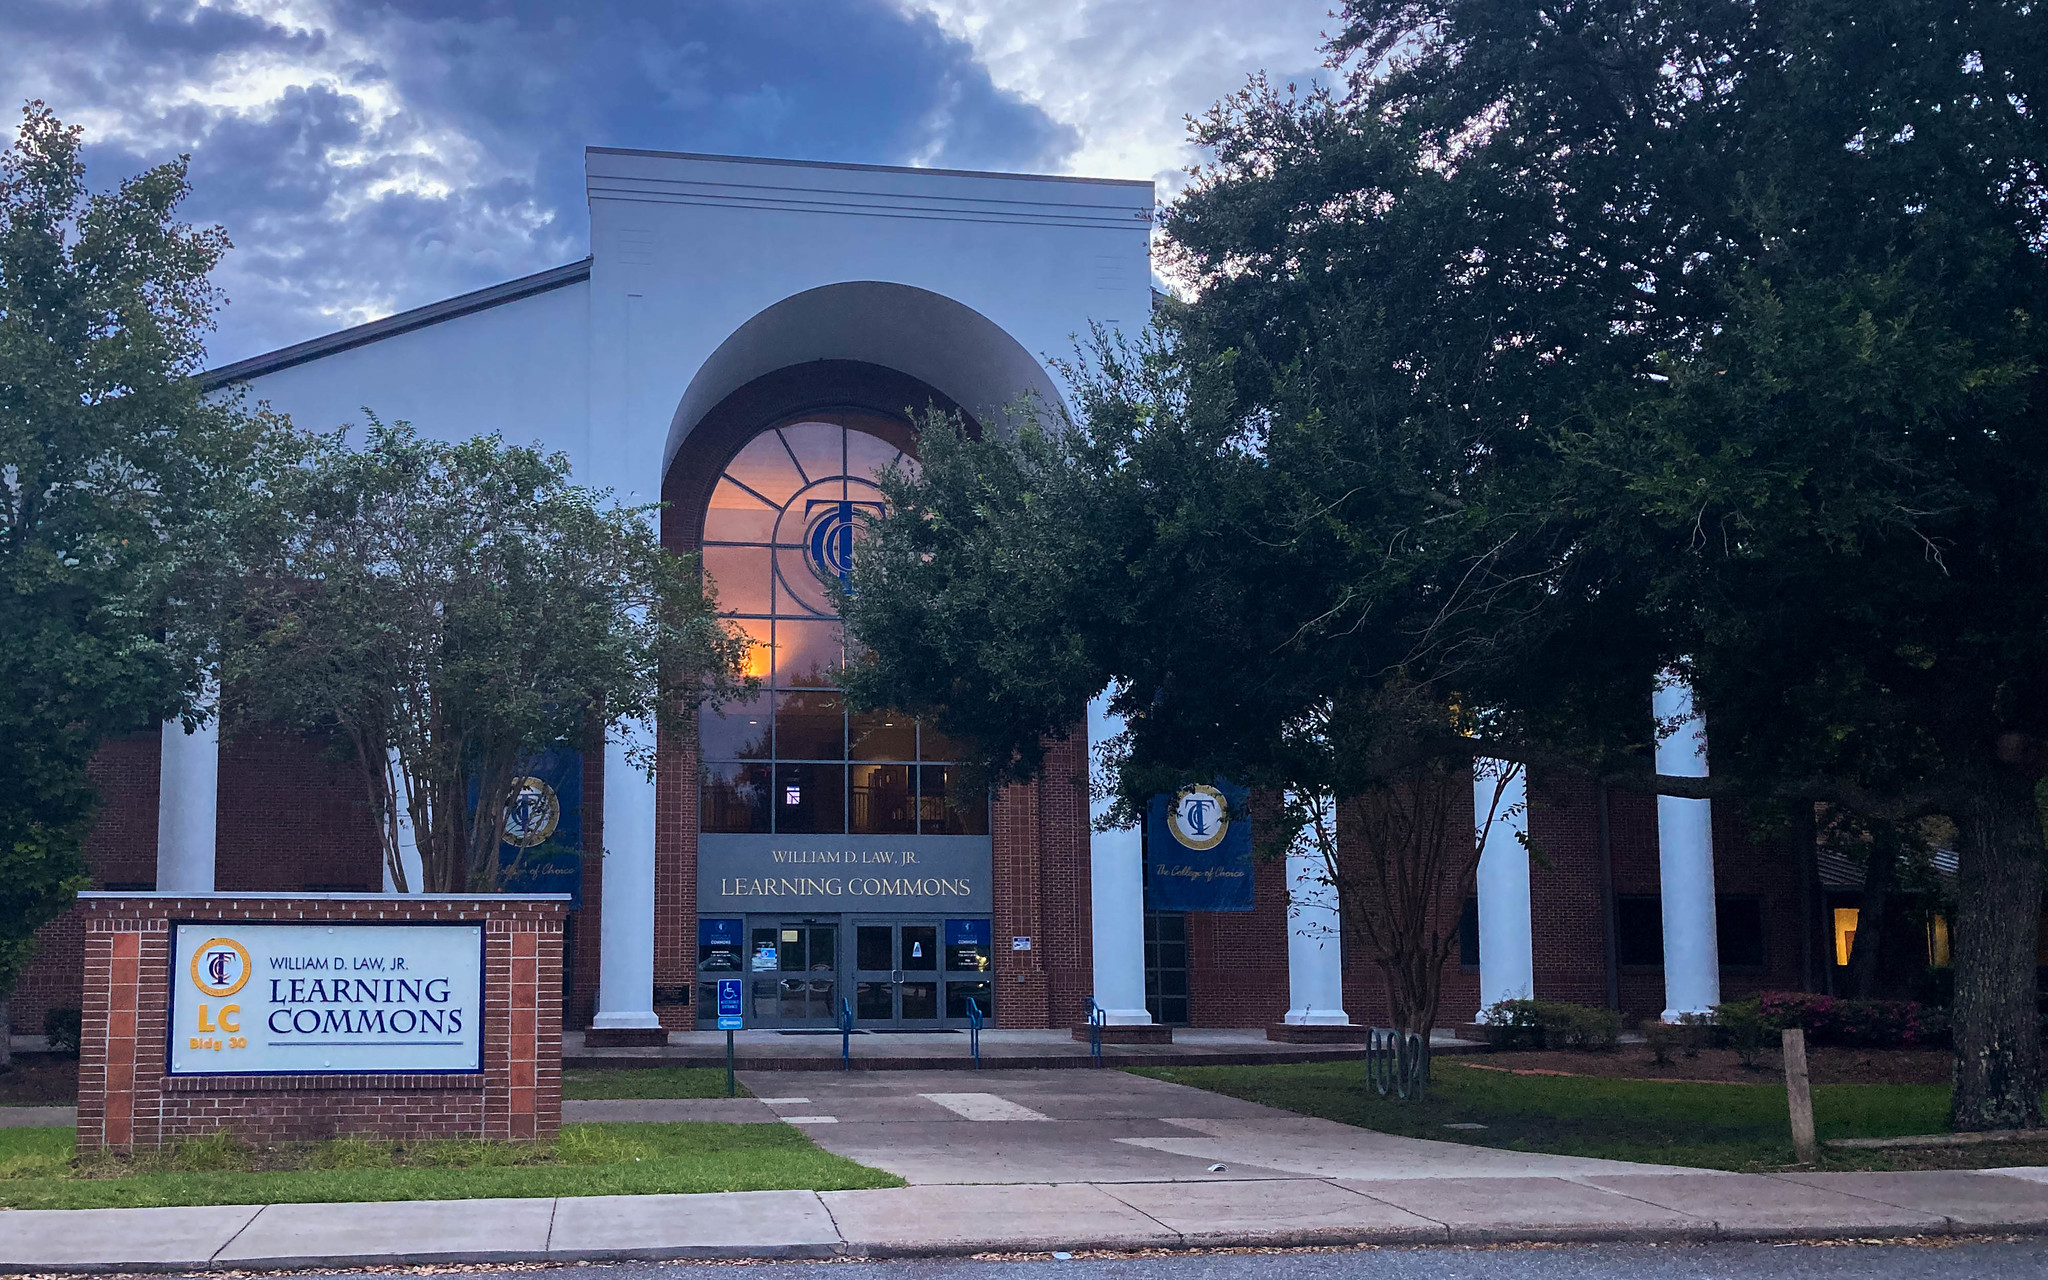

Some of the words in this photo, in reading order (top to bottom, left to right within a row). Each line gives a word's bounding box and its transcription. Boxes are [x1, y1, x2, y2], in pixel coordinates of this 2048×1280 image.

[772, 850, 840, 863] WILLIAM
[844, 851, 858, 863] D.
[862, 851, 898, 865] LAW,
[901, 851, 921, 866] JR.
[1157, 864, 1169, 876] The
[1171, 865, 1202, 881] College
[1204, 867, 1215, 882] of
[721, 878, 842, 896] LEARNING
[848, 878, 971, 896] COMMONS
[269, 957, 329, 970] WILLIAM
[334, 957, 347, 970] D.
[353, 957, 385, 972] LAW,
[390, 957, 409, 970] JR.
[269, 977, 451, 1005] LEARNING
[198, 1004, 240, 1032] LC
[268, 1007, 462, 1035] COMMONS
[189, 1037, 222, 1051] Bldg
[228, 1037, 247, 1048] 30
